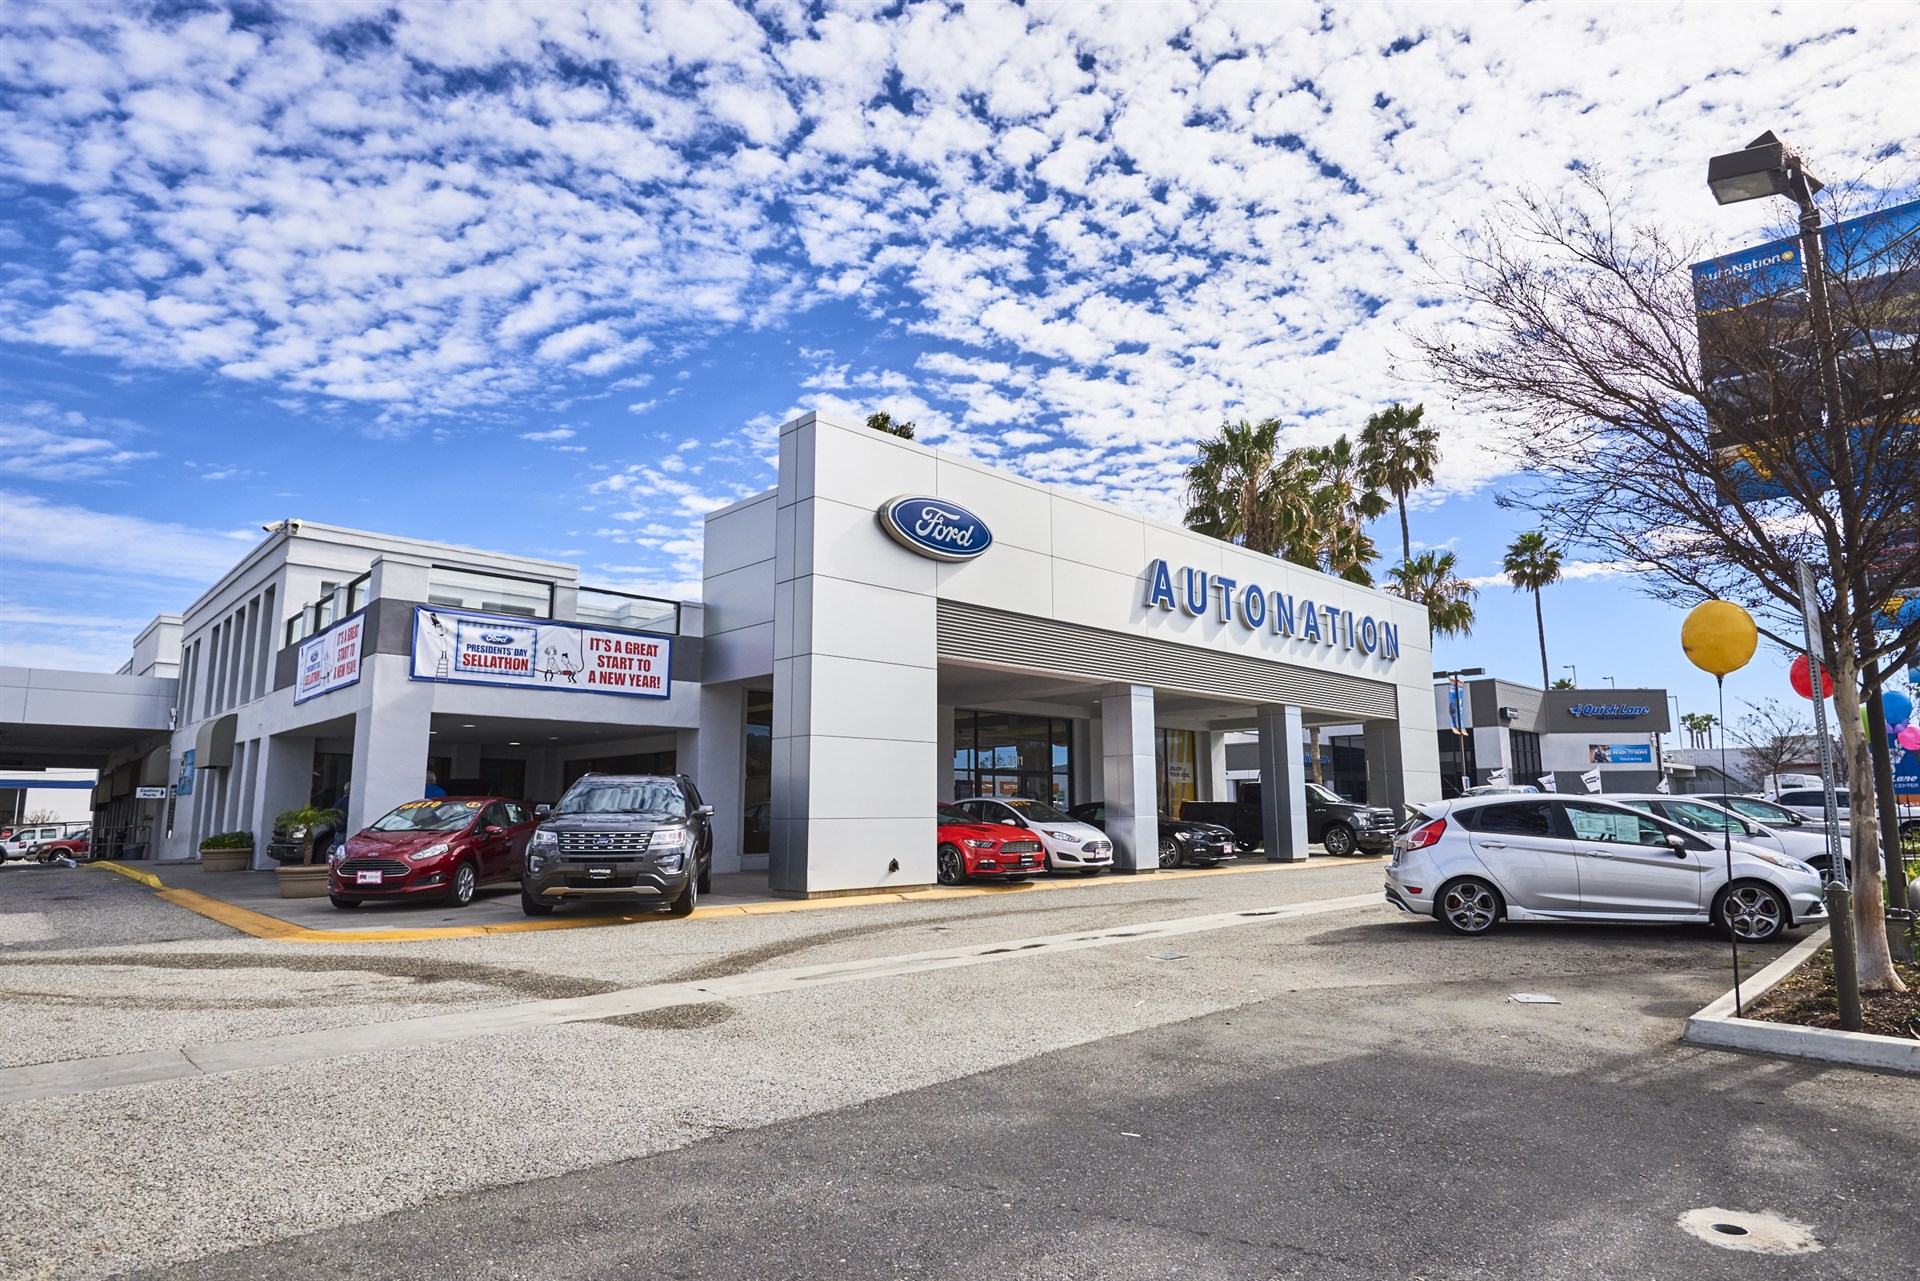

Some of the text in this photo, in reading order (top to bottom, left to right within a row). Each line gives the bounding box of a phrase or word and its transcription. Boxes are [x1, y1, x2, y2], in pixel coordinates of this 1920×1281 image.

[915, 506, 974, 547] Ford
[1146, 558, 1400, 660] AUTONATION
[347, 624, 360, 641] GREAT
[485, 633, 508, 643] Ford
[337, 643, 356, 662] START TO
[467, 643, 528, 657] PRESIDENTS' DAY
[590, 637, 659, 657] IT'S A GREAT
[337, 663, 346, 678] NEW
[462, 653, 529, 671] SELLATHON
[597, 654, 651, 672] START TO
[588, 670, 661, 689] A NEW YEAR!
[1583, 704, 1650, 716] Quick Lane
